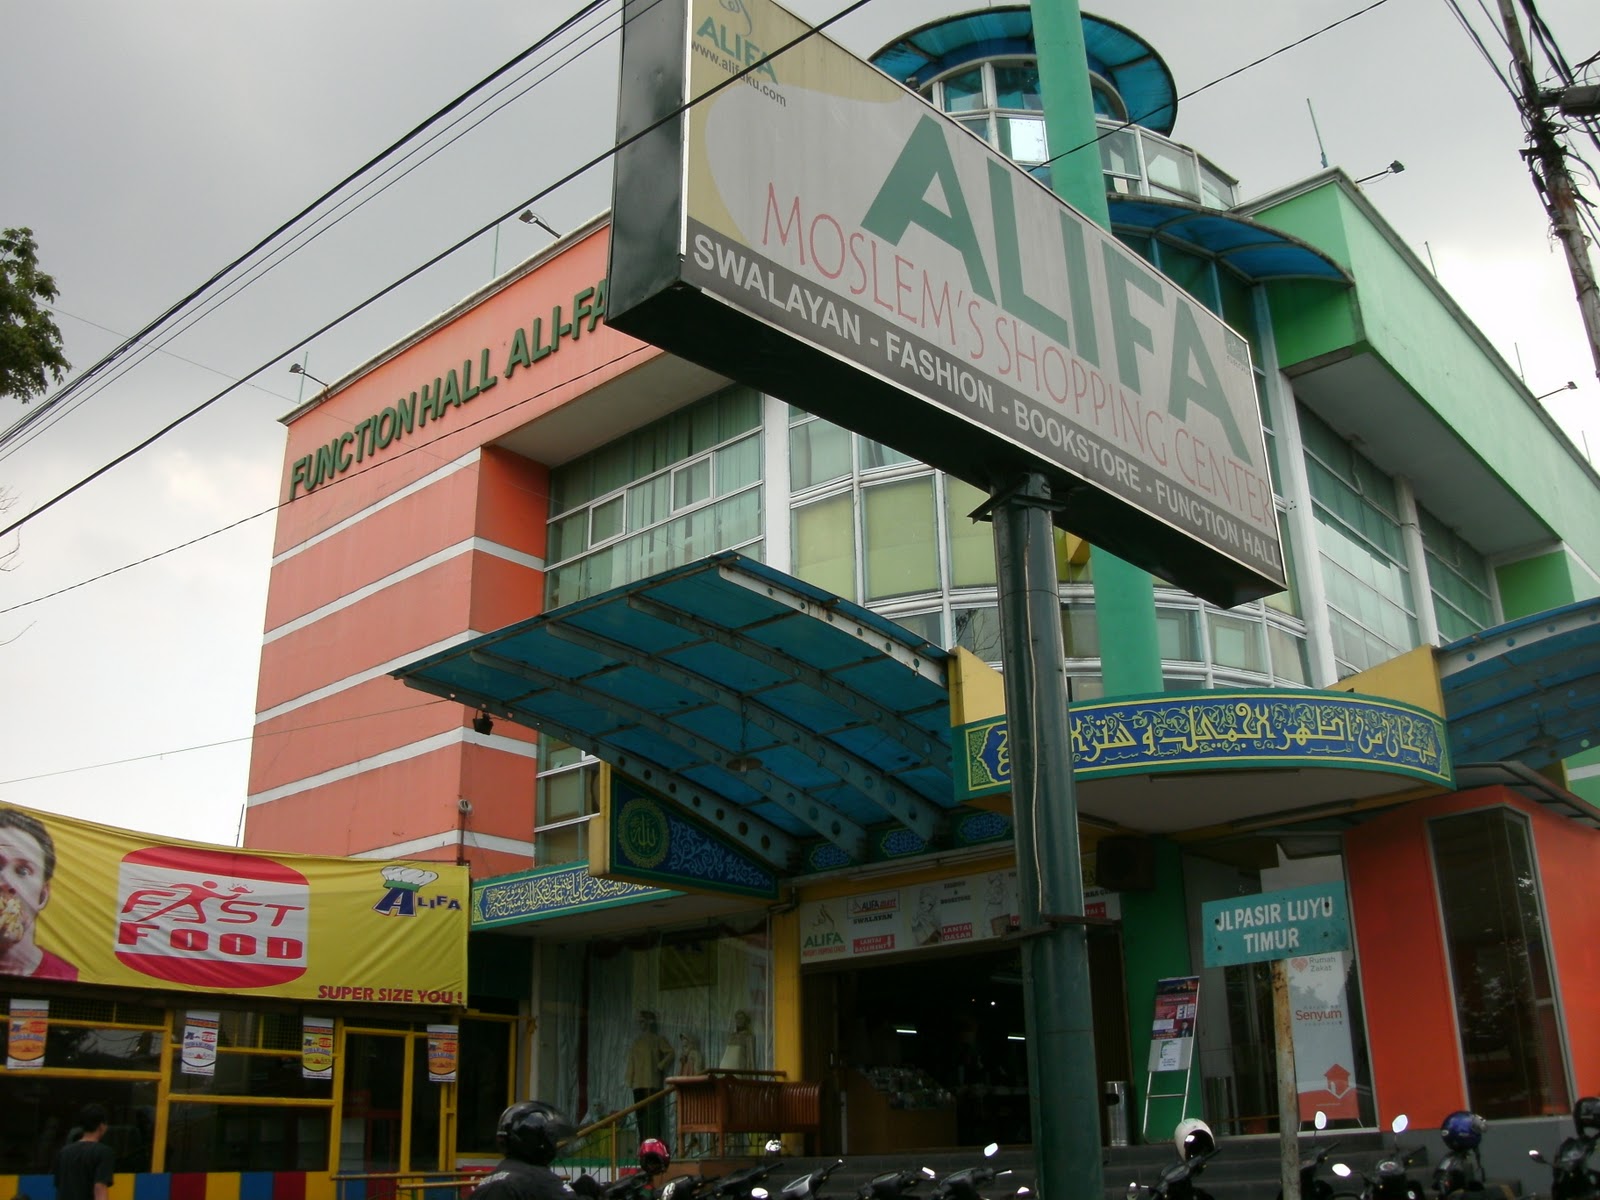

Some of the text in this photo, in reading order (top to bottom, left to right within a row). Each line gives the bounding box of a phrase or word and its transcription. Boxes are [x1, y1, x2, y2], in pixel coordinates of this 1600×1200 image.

[696, 16, 778, 85] ALIFA
[860, 113, 1251, 465] ALIFA
[763, 182, 1273, 523] MOSLEM'S SHOPPING CENTER
[693, 235, 861, 346] SWALAYAN
[886, 335, 994, 415] FASHION
[1014, 398, 1142, 493] BOOKSTORE
[1155, 478, 1239, 544] FUNCTION
[1243, 522, 1282, 569] HALL
[289, 391, 416, 501] FUNCTION
[418, 347, 497, 427] HALL
[121, 880, 305, 927] FAST
[373, 887, 462, 917] ALIFA
[861, 899, 879, 911] ALIFA
[1234, 903, 1281, 929] PASIR
[1287, 896, 1333, 921] LUYU
[853, 912, 893, 924] SWALAYAN
[943, 924, 971, 934] LANTAI
[118, 922, 303, 960] FOOD
[803, 931, 844, 948] ALIFA
[944, 932, 971, 941] DASAR
[1243, 928, 1300, 953] TIMUR
[1309, 956, 1336, 964] Rumah
[318, 985, 375, 1001] SUPER
[378, 988, 413, 1002] SIZE
[1296, 1010, 1342, 1022] Senyum
